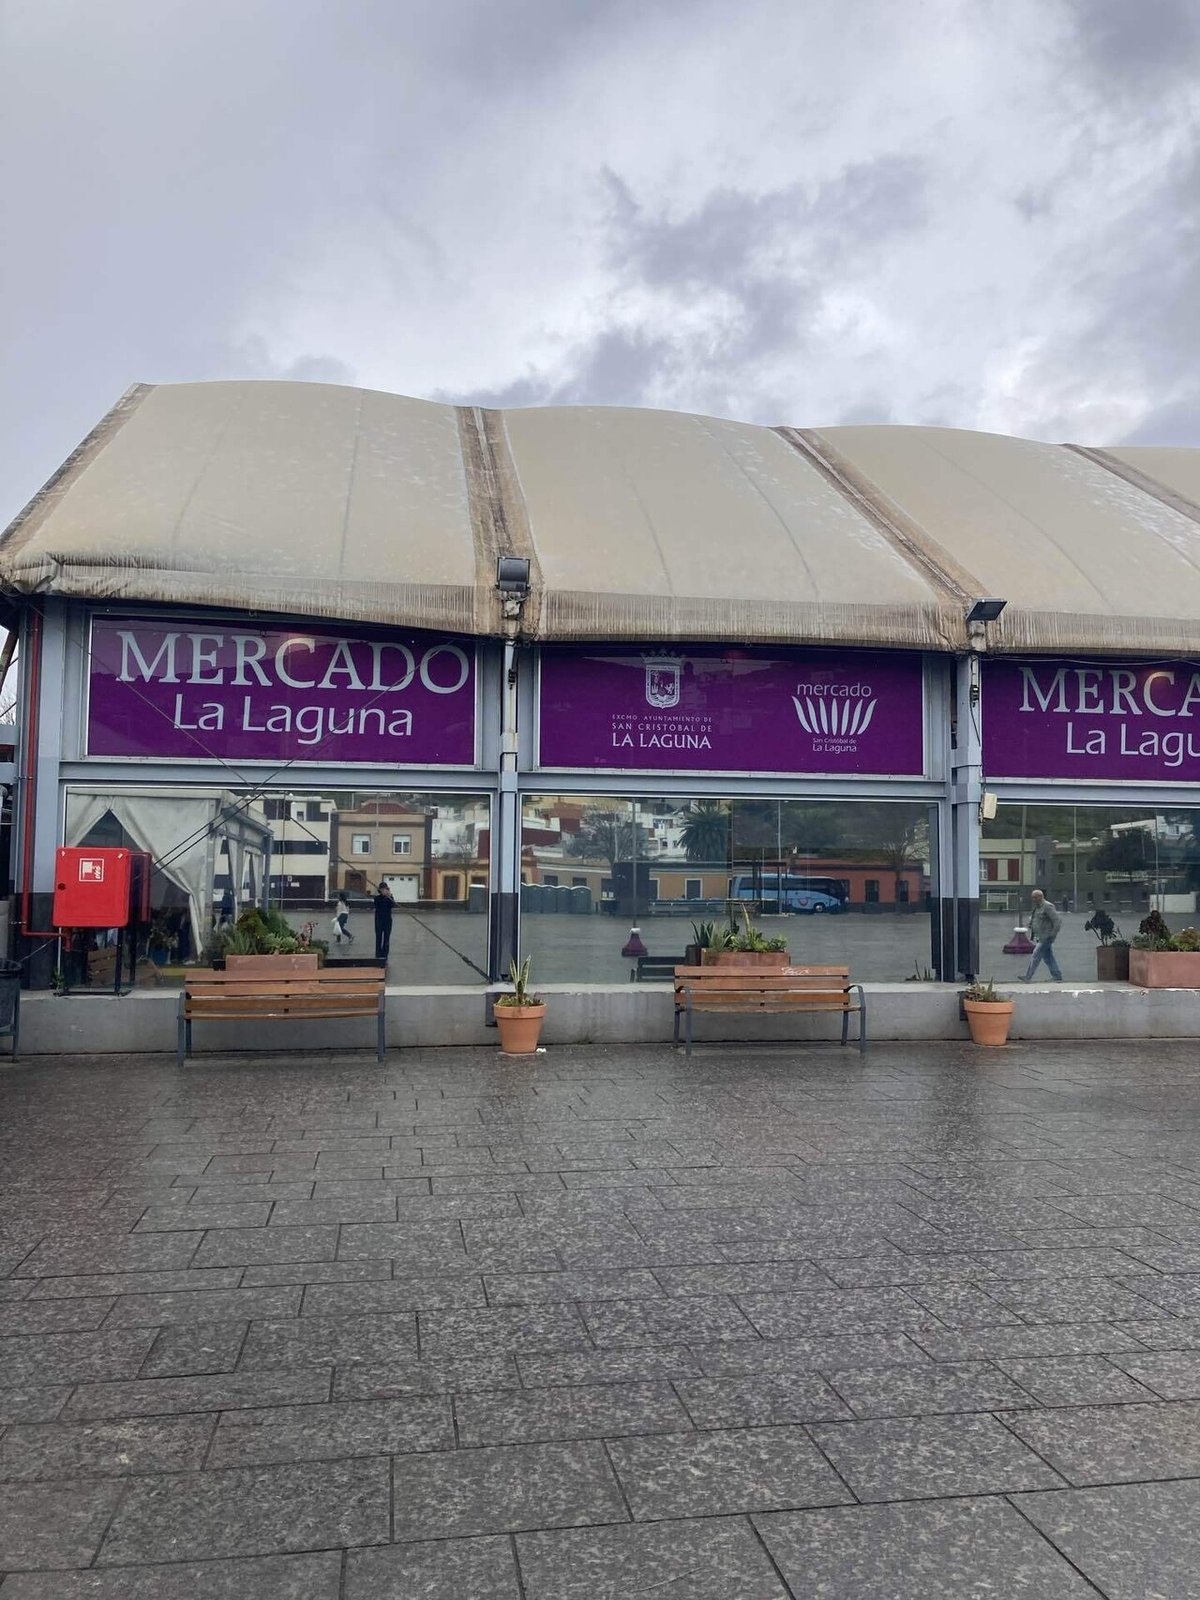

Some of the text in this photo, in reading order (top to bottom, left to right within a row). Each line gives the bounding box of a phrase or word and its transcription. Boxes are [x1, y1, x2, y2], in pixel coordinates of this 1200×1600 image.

[115, 631, 470, 694] MERCADO
[797, 682, 872, 697] mercado
[173, 693, 414, 745] La Laguna
[643, 715, 701, 723] AYUNTAMIENTO
[612, 722, 632, 730] SAN
[700, 725, 712, 733] DE
[612, 732, 712, 749] LA LAGUNA
[1066, 721, 1106, 755] La
[812, 743, 857, 754] La Laguna
